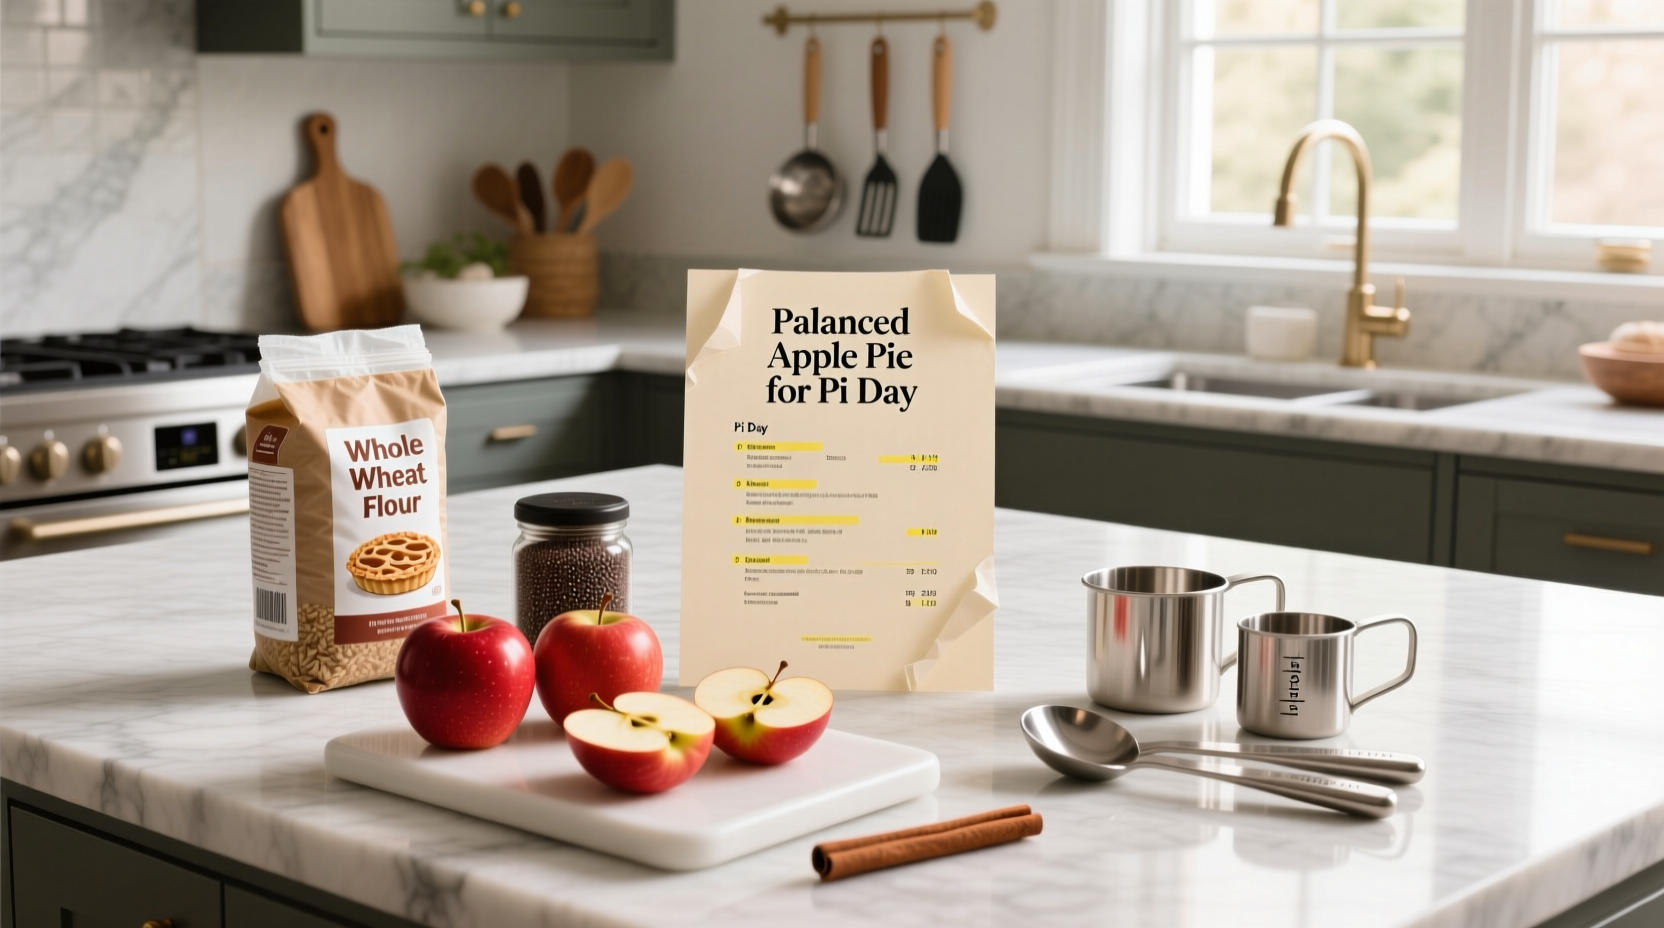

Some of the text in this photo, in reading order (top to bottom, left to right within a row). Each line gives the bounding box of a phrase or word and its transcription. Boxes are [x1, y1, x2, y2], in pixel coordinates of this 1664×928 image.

[772, 307, 911, 336] Palanced
[767, 341, 913, 377] Apple Pie
[766, 375, 918, 413] for Pi Day
[734, 421, 769, 436] Pi Day
[344, 433, 425, 463] Whole
[349, 463, 428, 491] Wheat
[363, 494, 422, 519] Flour
